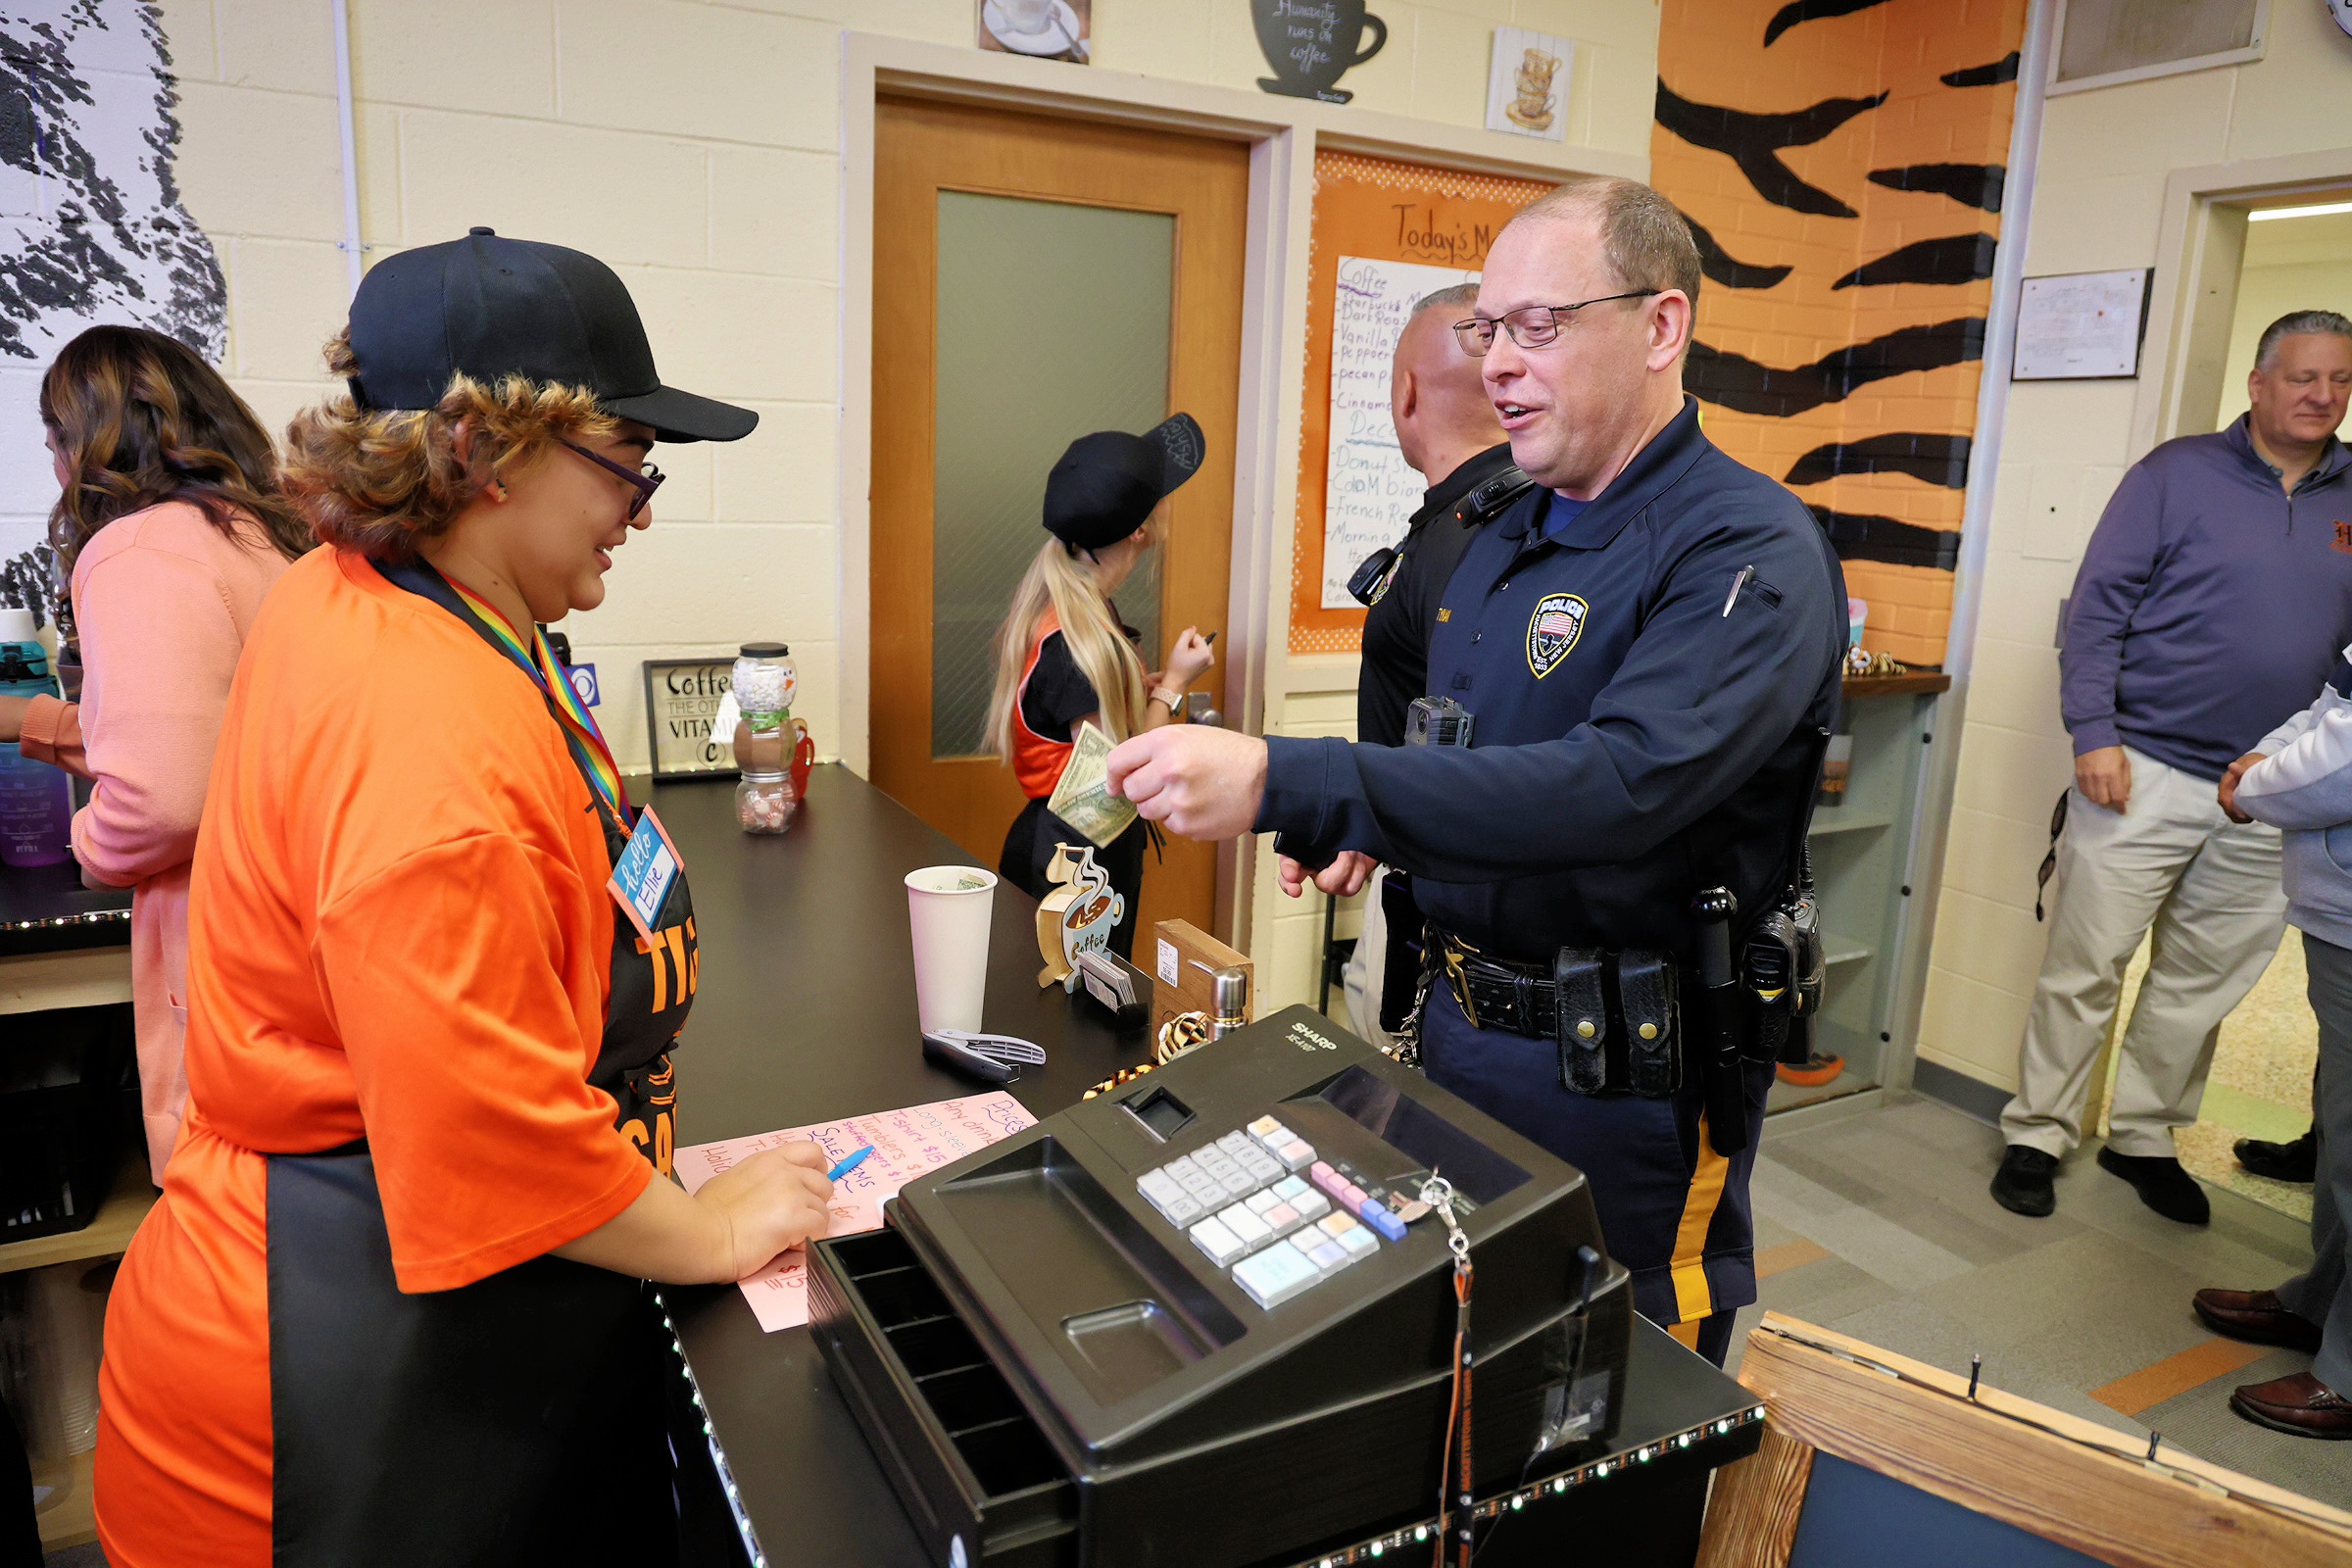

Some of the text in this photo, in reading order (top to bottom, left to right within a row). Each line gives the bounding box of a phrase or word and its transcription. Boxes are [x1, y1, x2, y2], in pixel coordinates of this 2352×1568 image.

[1273, 0, 1341, 30] Humanity
[1288, 24, 1314, 38] runs
[1290, 41, 1331, 74] coffee
[1392, 204, 1468, 264] Today's
[1340, 258, 1388, 291] Coffee
[1343, 293, 1402, 312] Starbucks
[1375, 310, 1408, 325] Roas
[1341, 323, 1388, 349] Vanilla
[1338, 368, 1375, 389] pecan
[1336, 444, 1388, 473] Donut
[1337, 496, 1383, 520] French
[1331, 520, 1391, 548] Morning
[1539, 599, 1585, 619] POLICE
[1548, 620, 1580, 662] NEW JERSEY
[667, 666, 733, 695] Coffe
[667, 701, 694, 714] THE
[621, 832, 651, 896] hello
[638, 867, 663, 911] Ellie
[1071, 934, 1105, 960] Coffee
[1292, 1023, 1337, 1050] SHARP
[940, 1101, 968, 1120] Any
[987, 1100, 1029, 1133] Prices
[812, 1127, 845, 1156] SALE
[858, 1115, 906, 1160] Tumblers
[887, 1110, 948, 1163] T-shirt $15
[830, 1206, 859, 1219] for
